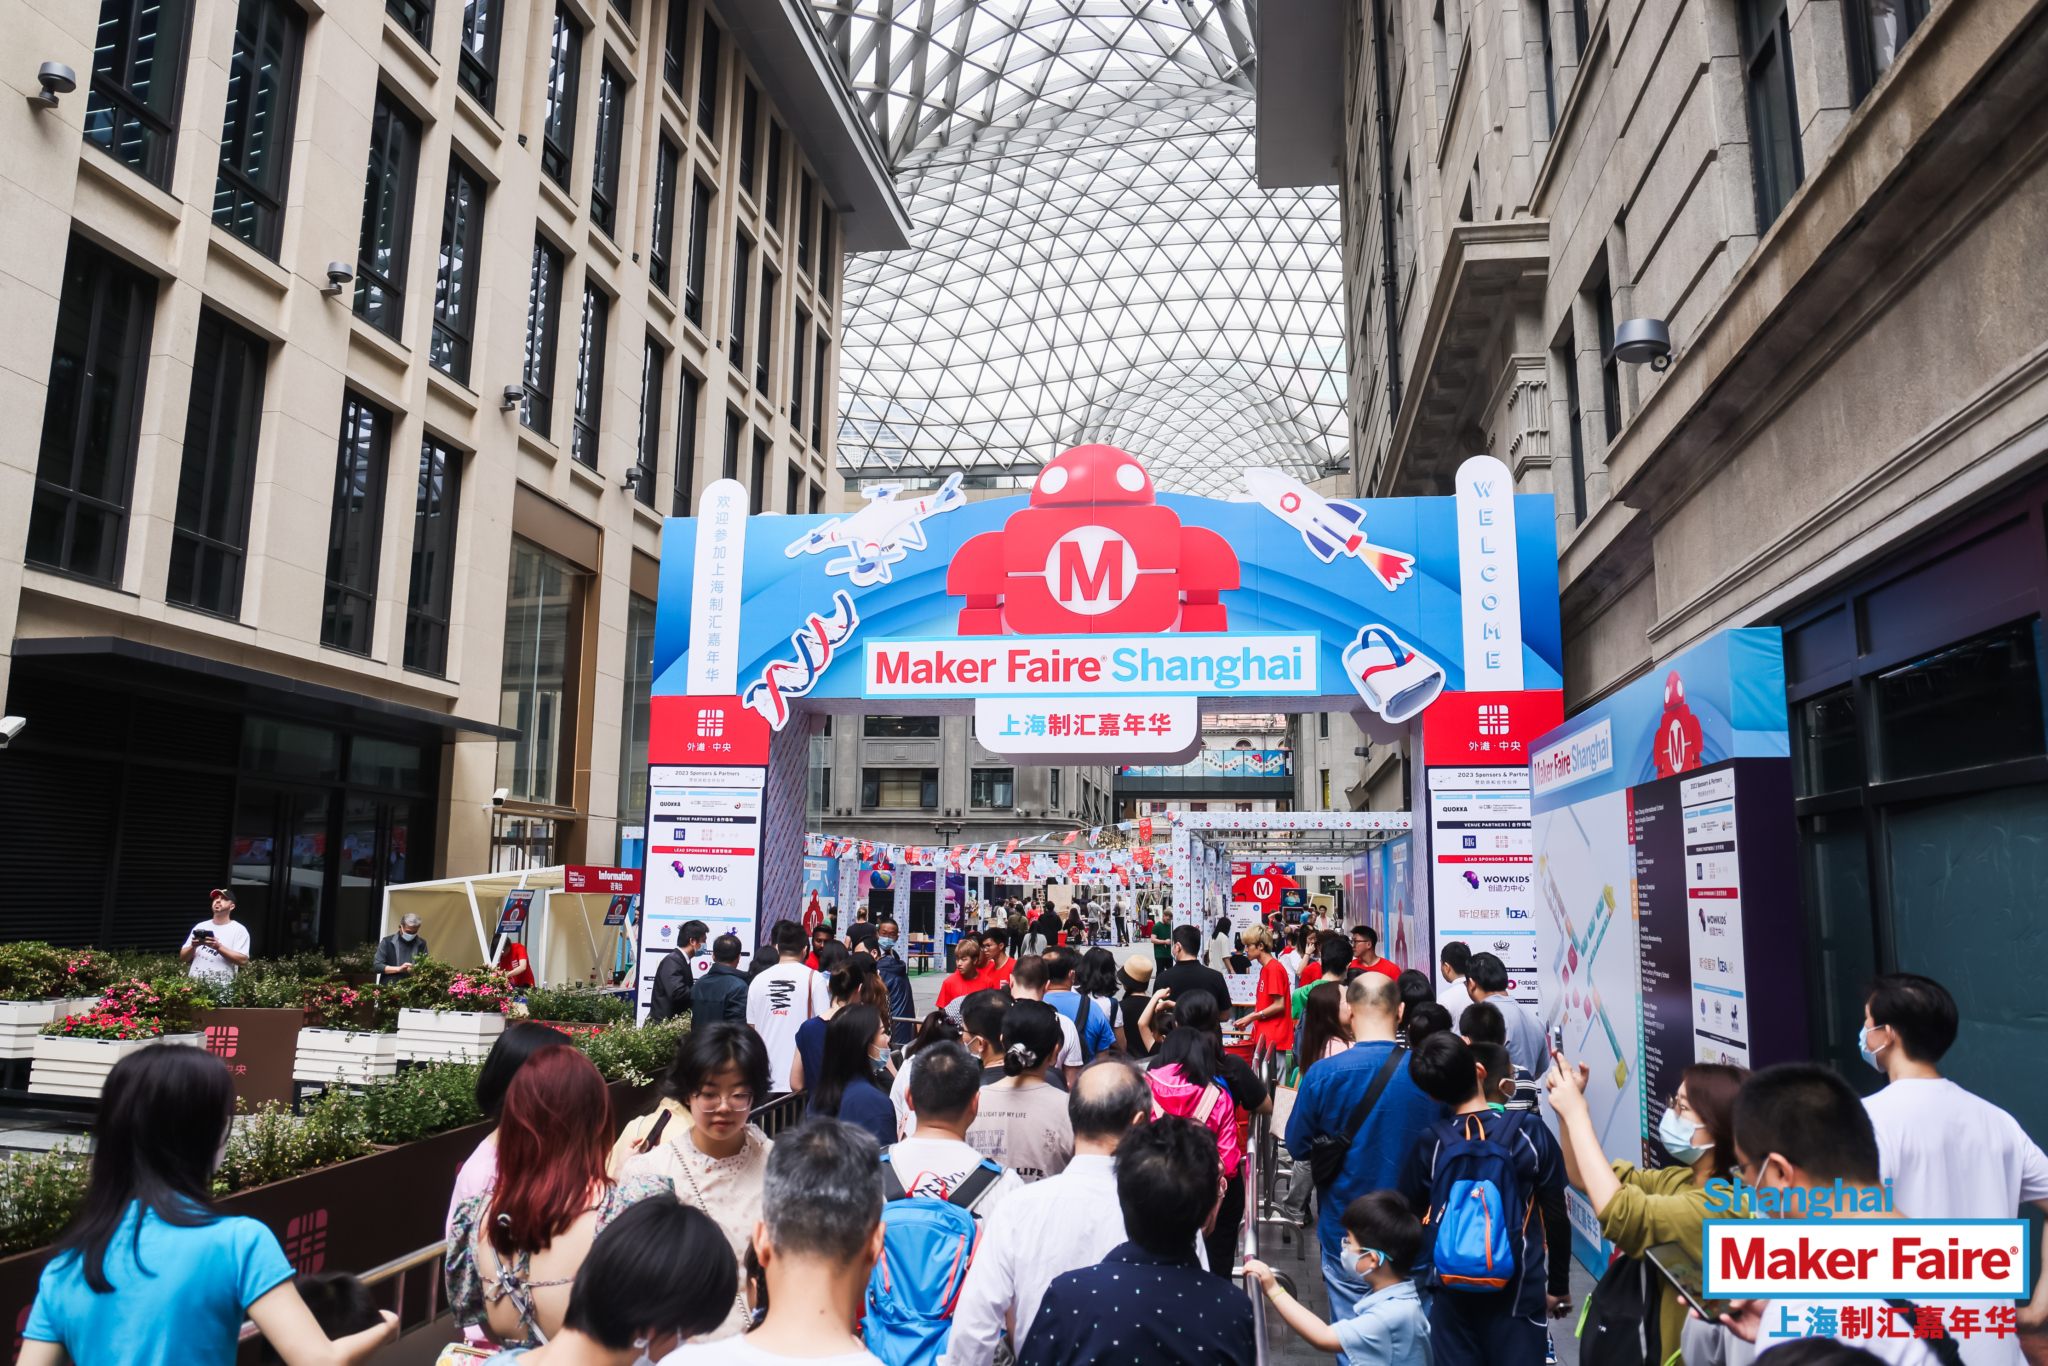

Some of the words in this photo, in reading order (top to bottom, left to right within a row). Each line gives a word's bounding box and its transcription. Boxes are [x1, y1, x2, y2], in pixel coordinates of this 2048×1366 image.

[1059, 539, 1123, 602] M
[1472, 479, 1502, 670] WELCOME
[705, 494, 731, 683] 欢迎参加上海制汇嘉年华
[875, 650, 997, 685] Maker
[1112, 646, 1302, 690] Shanghai
[999, 712, 1171, 737] 上海制汇嘉年华
[1534, 759, 1554, 787] Maker
[1554, 750, 1571, 780] Faire
[1571, 729, 1609, 772] Shanghai
[1464, 837, 1475, 847] BIG
[598, 870, 633, 881] Information
[688, 866, 728, 874] WOWKIDS
[691, 874, 723, 882] 创造力中心
[1488, 884, 1525, 892] 创造力中心
[665, 895, 700, 905] 斯坦星球
[1459, 909, 1500, 919] 斯坦星球
[1706, 915, 1727, 925] WOWKIDS
[1016, 1167, 1044, 1178] LIFE
